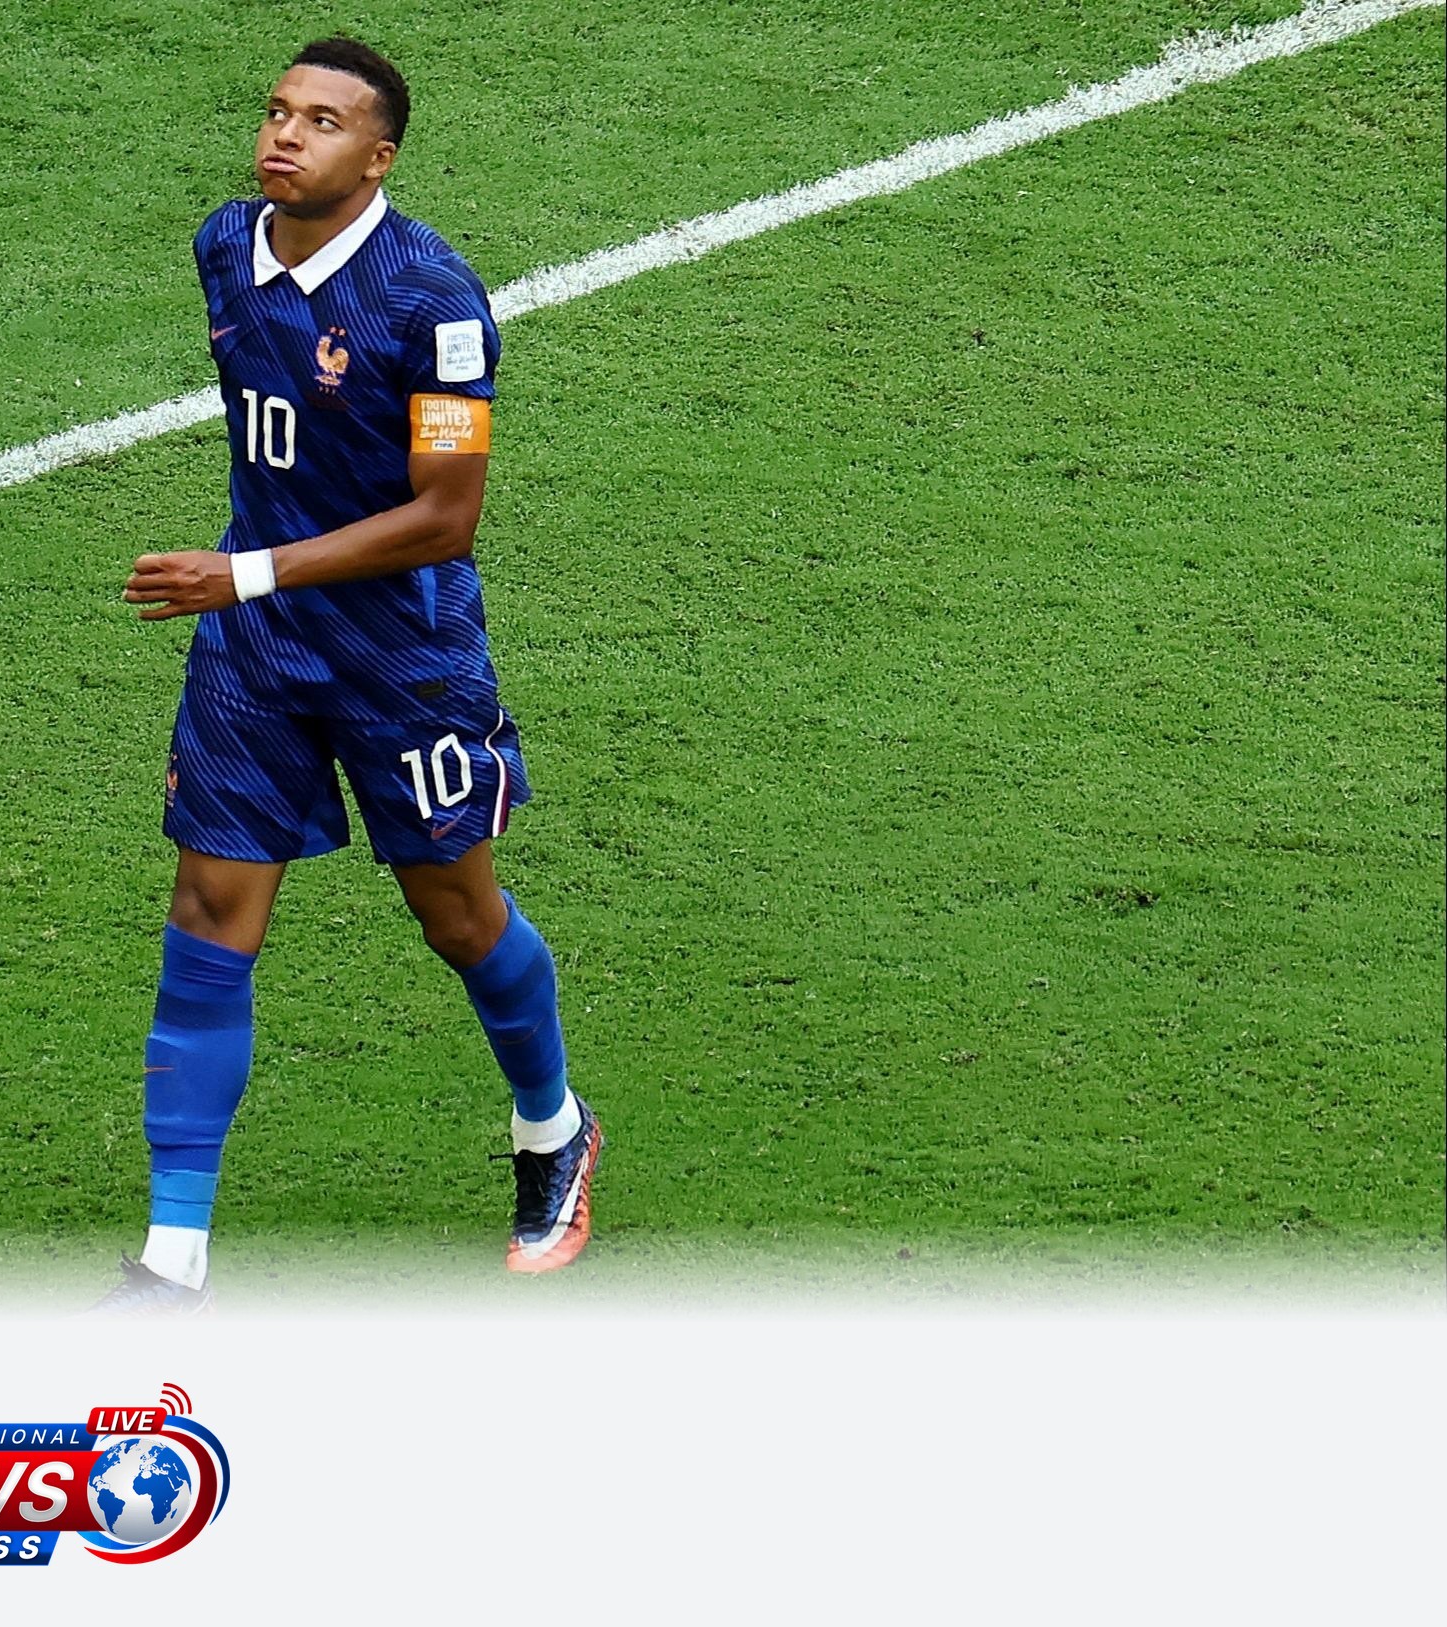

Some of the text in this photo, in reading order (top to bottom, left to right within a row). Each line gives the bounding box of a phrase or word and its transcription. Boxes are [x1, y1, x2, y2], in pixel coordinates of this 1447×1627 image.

[242, 388, 296, 470] 10
[422, 411, 472, 426] UNITES
[401, 733, 473, 820] 10
